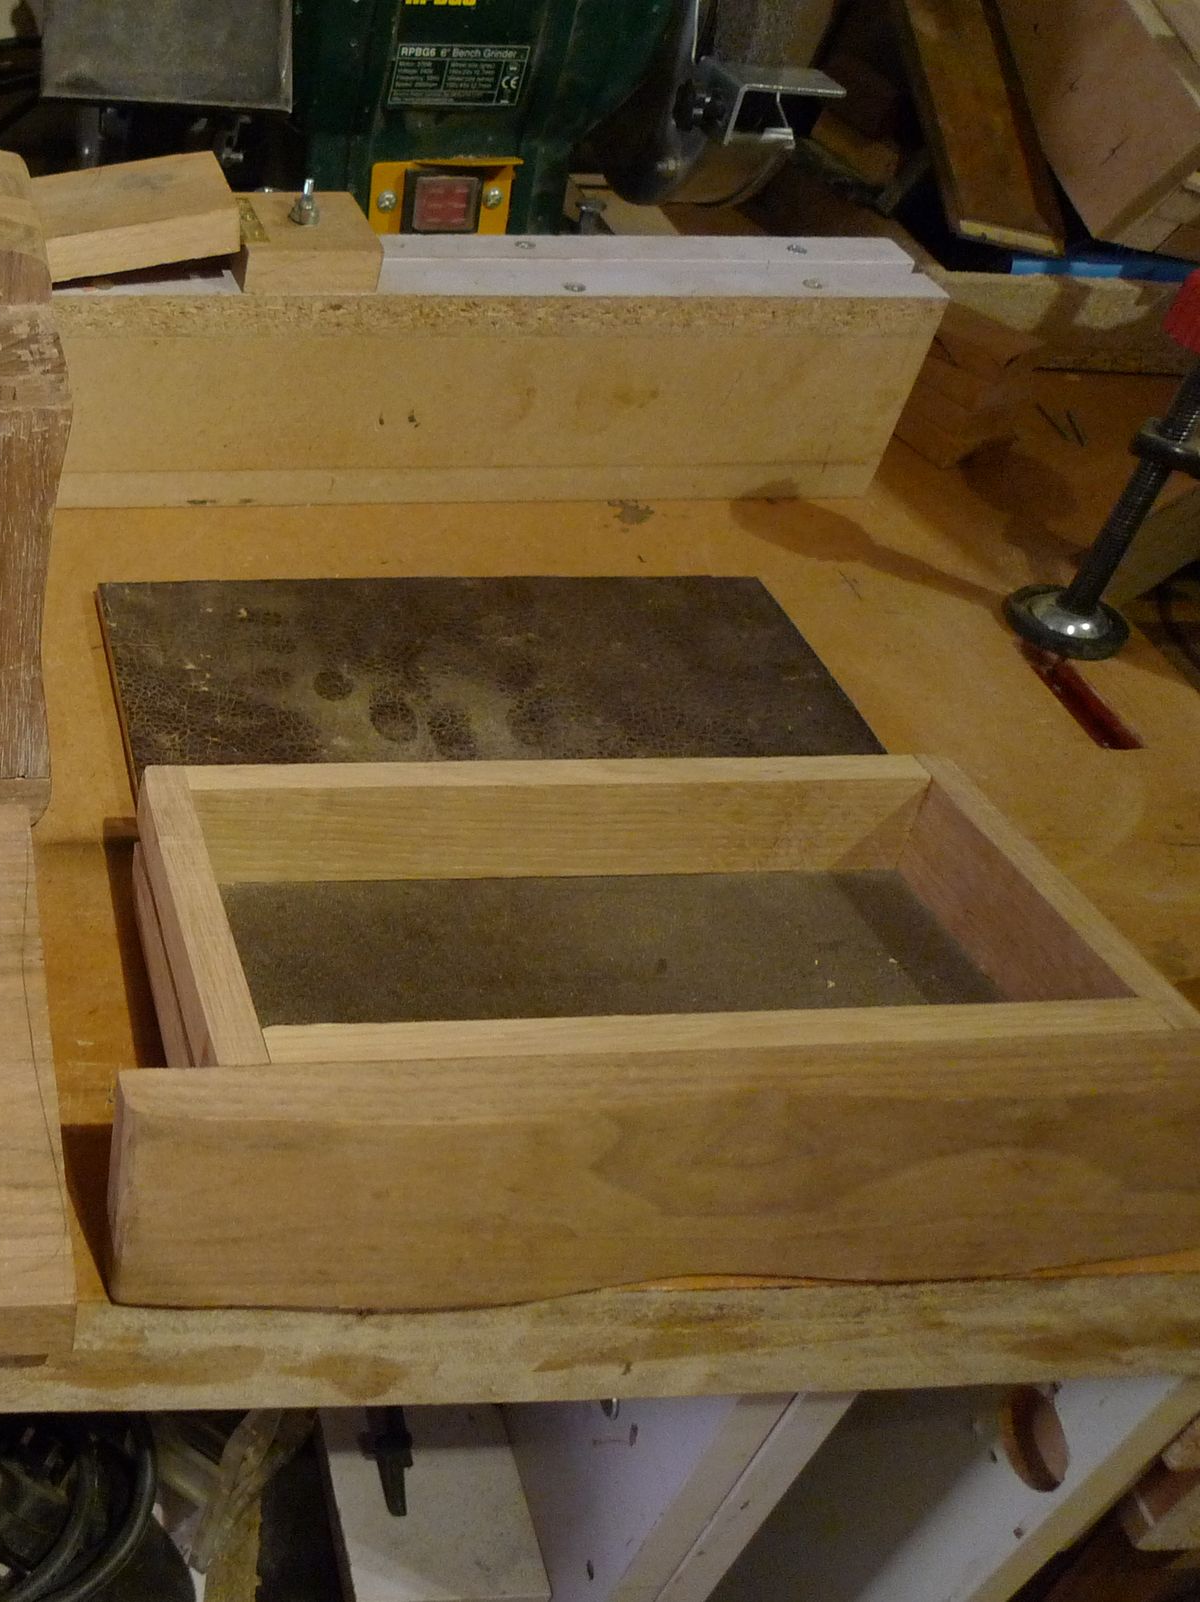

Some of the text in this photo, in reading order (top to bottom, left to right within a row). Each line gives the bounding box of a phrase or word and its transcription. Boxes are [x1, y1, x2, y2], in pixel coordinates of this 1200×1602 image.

[401, 47, 437, 58] RPBG6
[452, 48, 481, 58] Bench
[483, 48, 517, 59] Grinder
[501, 76, 519, 89] CE
